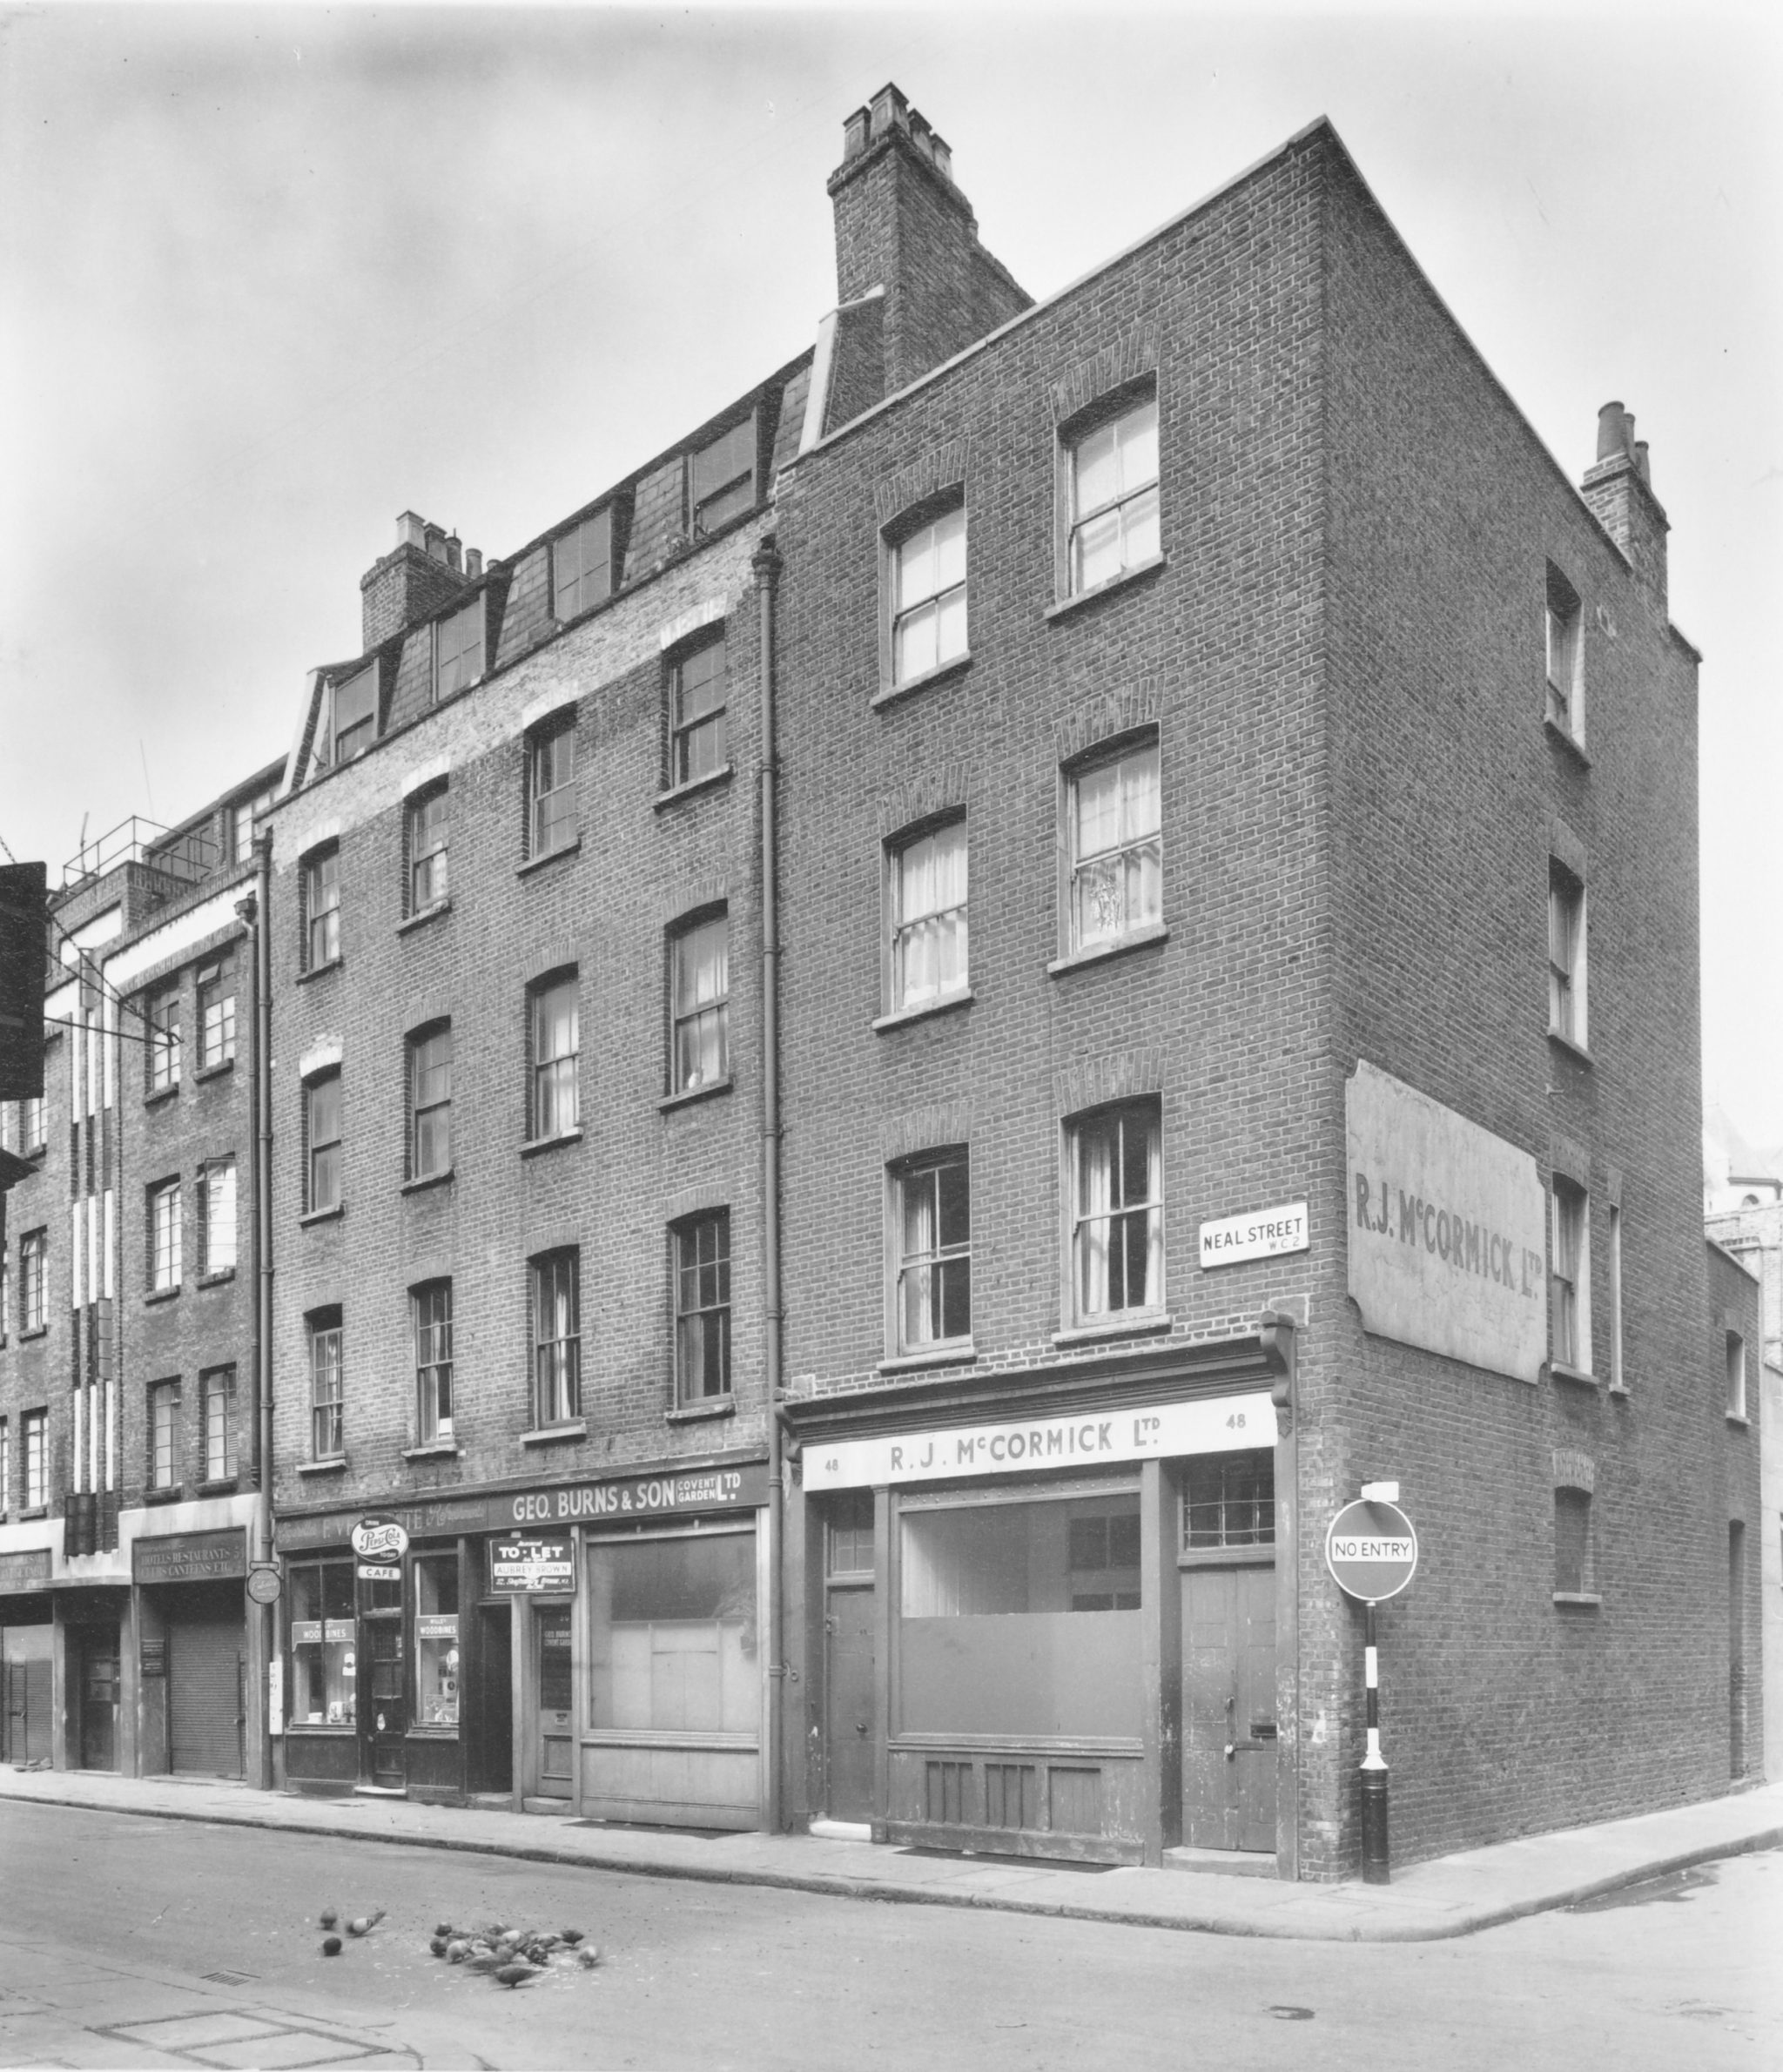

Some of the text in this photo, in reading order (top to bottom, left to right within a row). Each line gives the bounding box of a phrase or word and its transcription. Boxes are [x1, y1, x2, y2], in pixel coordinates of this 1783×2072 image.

[1204, 1218, 1302, 1251] NEAL STREET
[1399, 1189, 1515, 1290] McCORMICK
[1226, 1413, 1247, 1430] 48
[957, 1423, 1112, 1464] McCORMICK
[824, 1458, 839, 1471] 48
[513, 1494, 551, 1521] GEO.
[557, 1486, 618, 1517] BURNS
[621, 1490, 632, 1510] &
[636, 1480, 676, 1509] SON
[1336, 1542, 1410, 1557] NO ENTRY
[367, 1568, 394, 1578] CAFE
